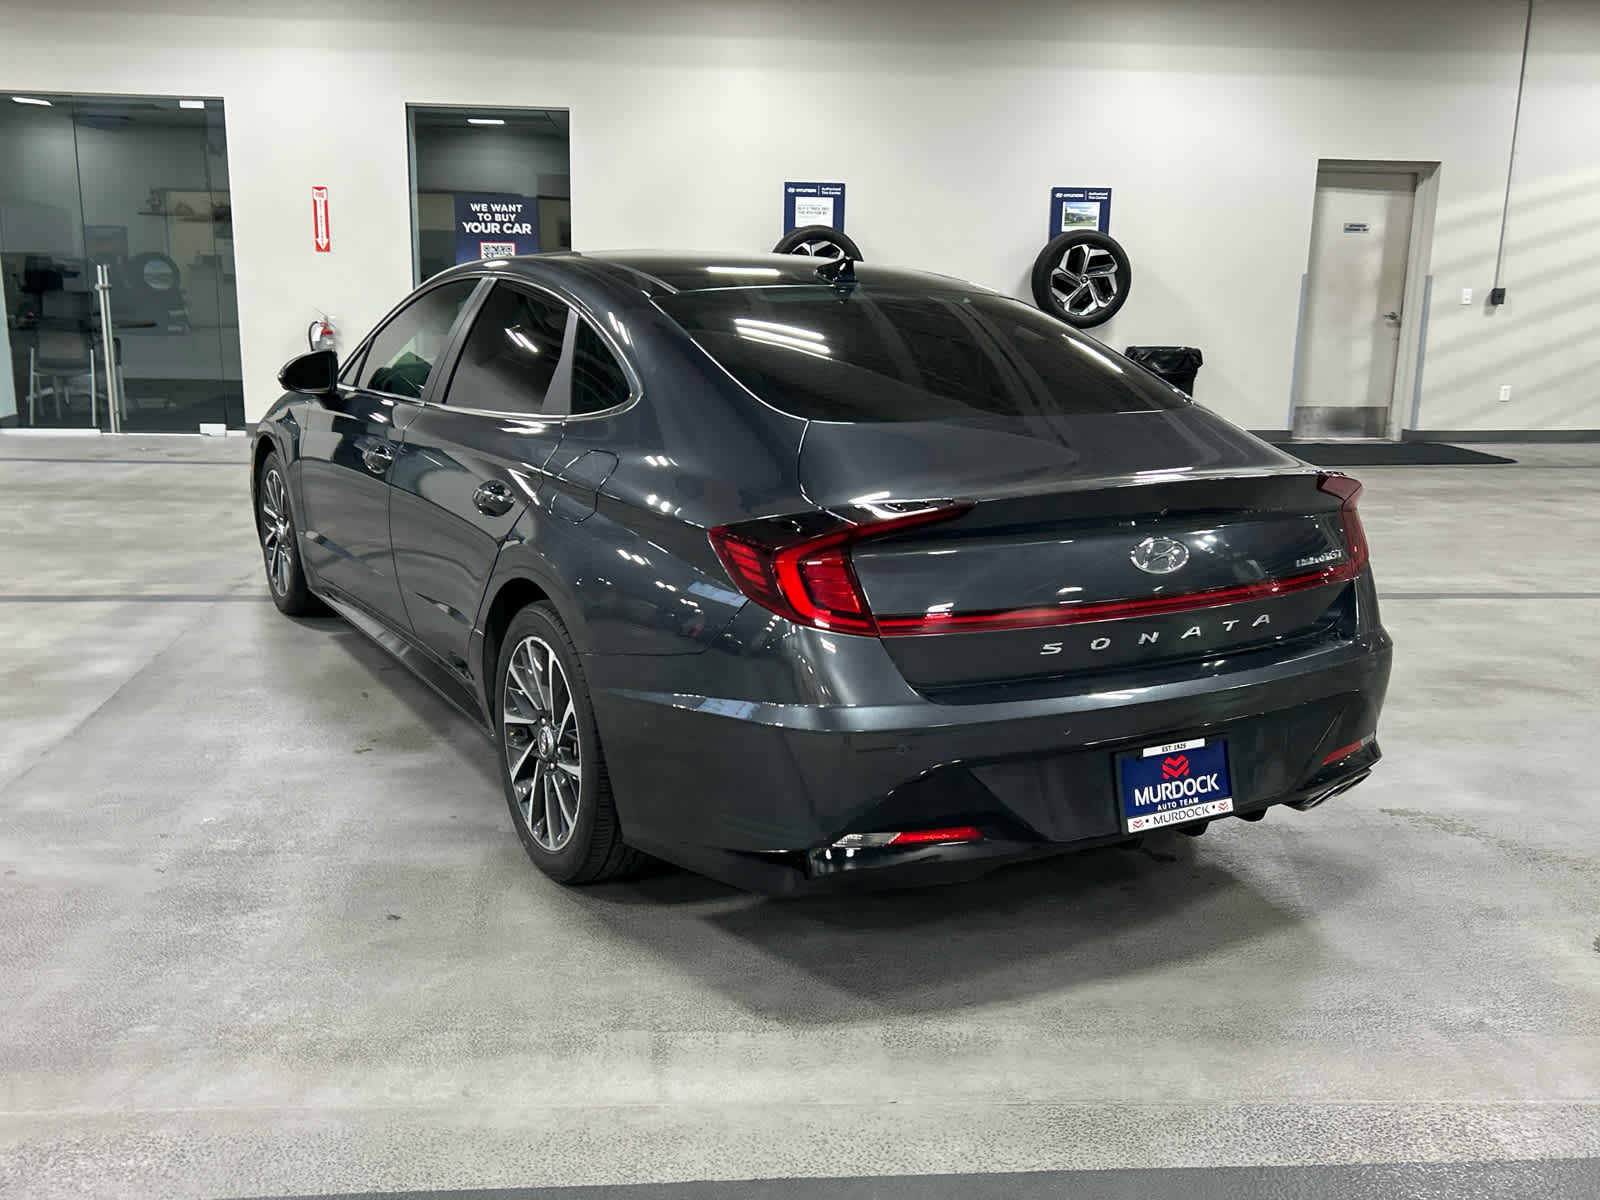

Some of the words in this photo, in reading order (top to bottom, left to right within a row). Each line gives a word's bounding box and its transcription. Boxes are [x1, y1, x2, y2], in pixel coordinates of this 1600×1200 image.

[470, 203, 488, 212] WE
[490, 203, 523, 213] WANT
[477, 213, 492, 221] TO
[494, 213, 517, 222] BUY
[462, 222, 501, 234] YOUR
[502, 222, 532, 235] CAR
[1040, 614, 1271, 655] SONATA
[1161, 745, 1172, 753] EST
[1134, 773, 1220, 807] MURDOCK
[1157, 802, 1177, 812] AUTO
[1180, 797, 1199, 807] TEAM
[1153, 806, 1210, 825] MURDOCK
